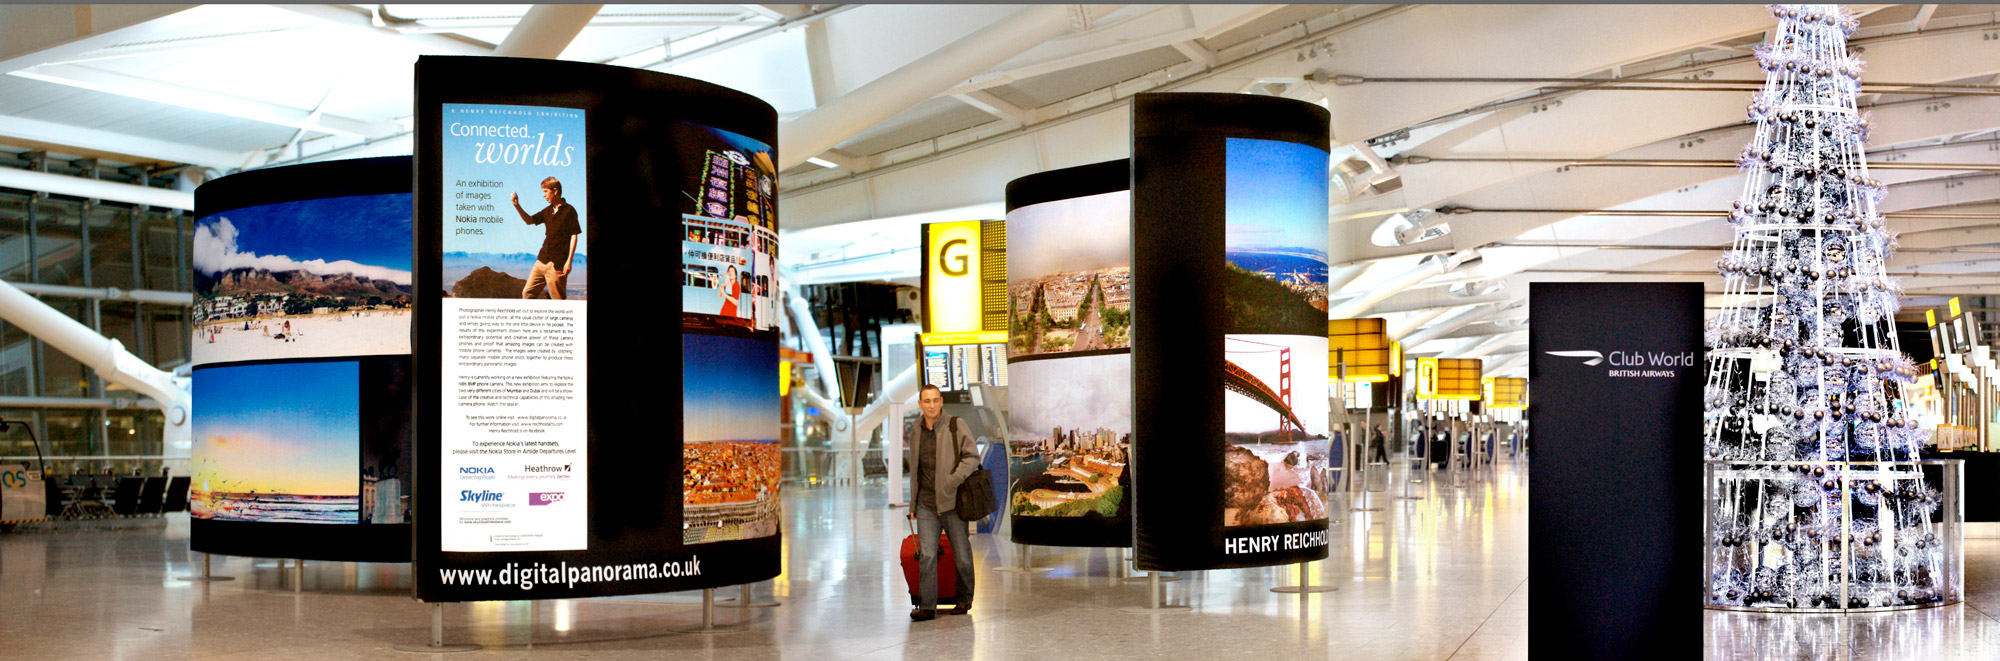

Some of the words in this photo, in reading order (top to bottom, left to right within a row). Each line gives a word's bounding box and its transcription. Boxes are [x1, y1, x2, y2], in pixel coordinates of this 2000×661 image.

[475, 132, 574, 167] worlds
[468, 180, 503, 188] exhibition
[466, 191, 491, 200] images
[456, 227, 484, 236] phones.
[940, 238, 968, 277] G
[1609, 351, 1644, 366] Club
[1648, 352, 1693, 366] World
[460, 490, 503, 503] Skyline
[540, 494, 564, 502] expo
[1225, 535, 1279, 554] HENRY
[440, 555, 701, 590] www.digitalpanorama.co.uk
